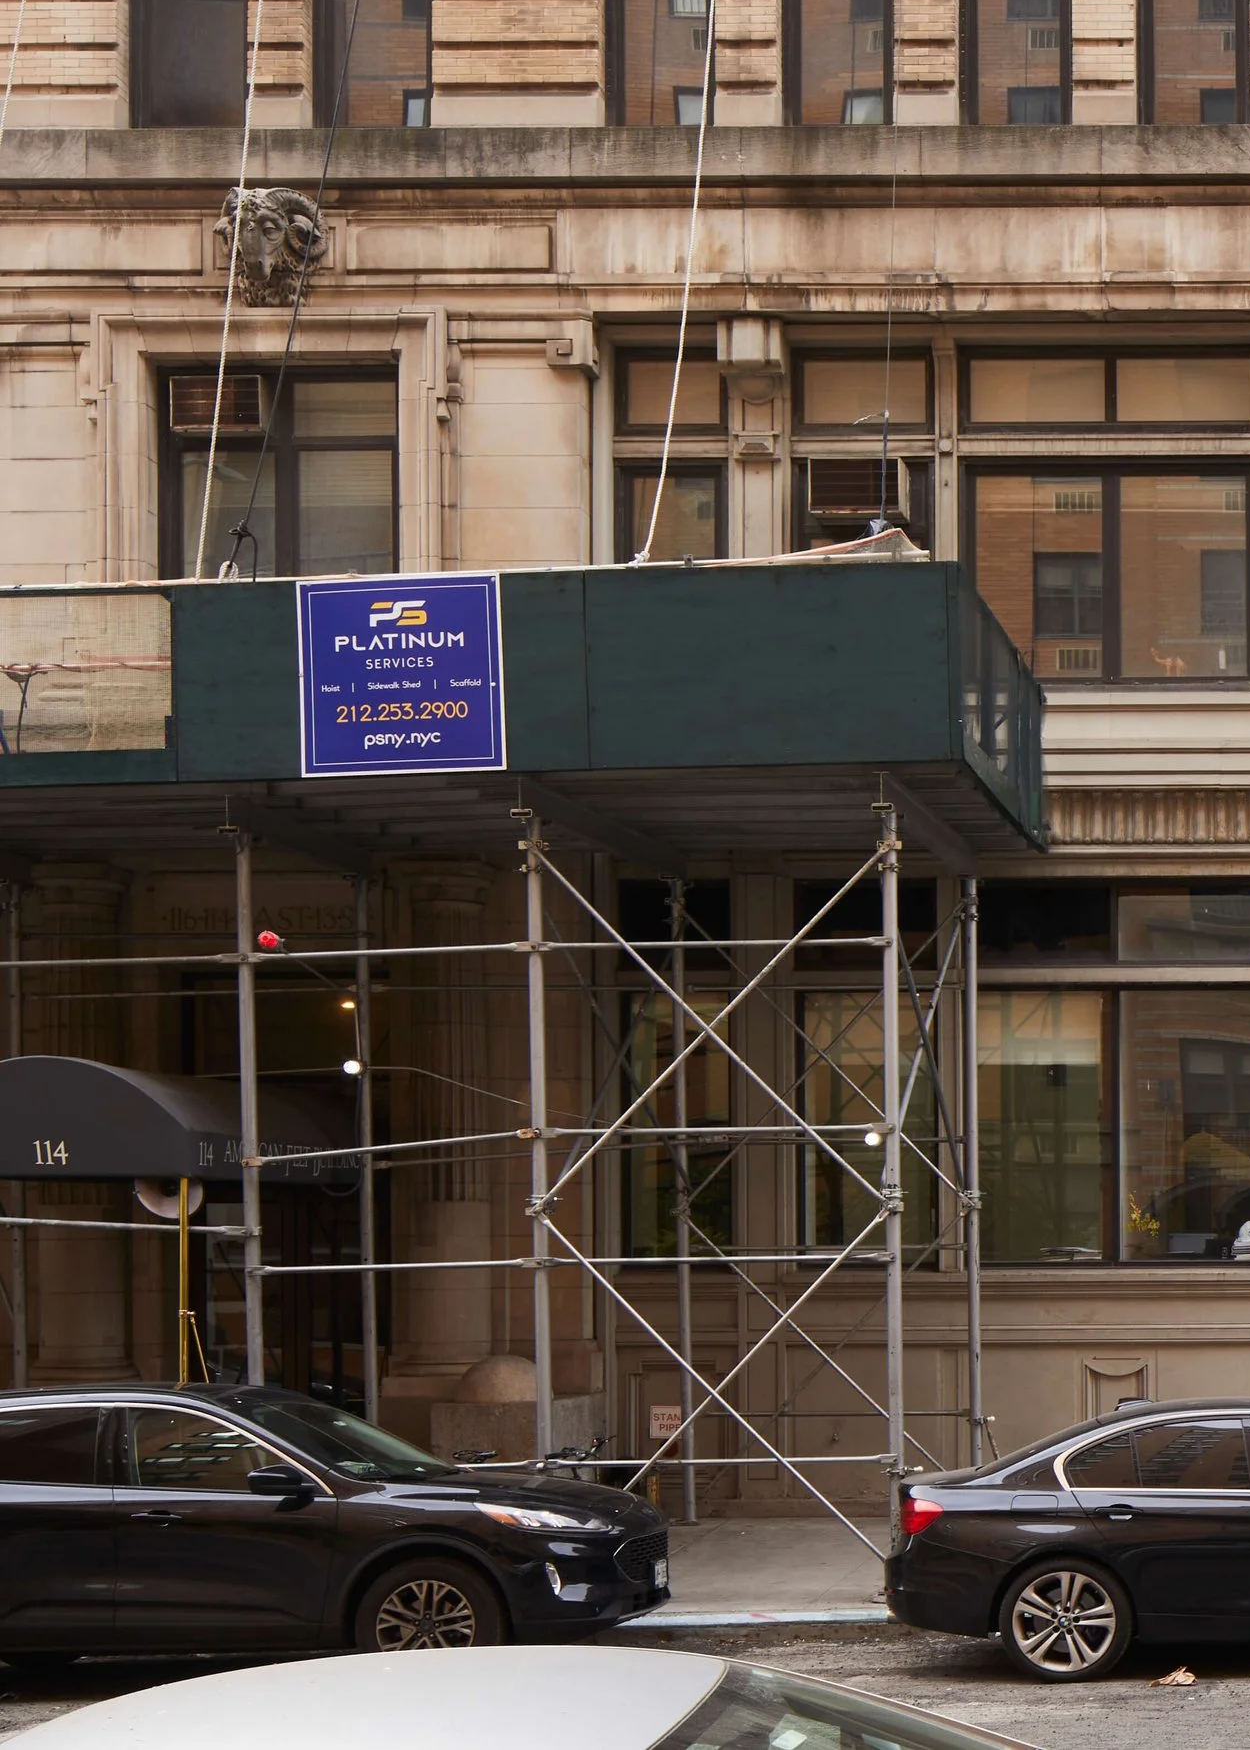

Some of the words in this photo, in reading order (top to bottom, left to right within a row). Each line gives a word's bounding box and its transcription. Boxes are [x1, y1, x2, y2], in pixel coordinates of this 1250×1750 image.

[334, 631, 465, 653] PLATINUM
[365, 656, 435, 670] SERVICES
[321, 684, 341, 693] Hoist
[367, 681, 400, 690] Sidewalk
[401, 680, 421, 689] Shed
[449, 678, 482, 687] Scaffold
[335, 700, 469, 724] 212.253.2900
[364, 730, 441, 751] psny.nyc
[33, 1139, 69, 1166] 114
[198, 1141, 214, 1166] 114
[223, 1139, 283, 1166] AMCAN
